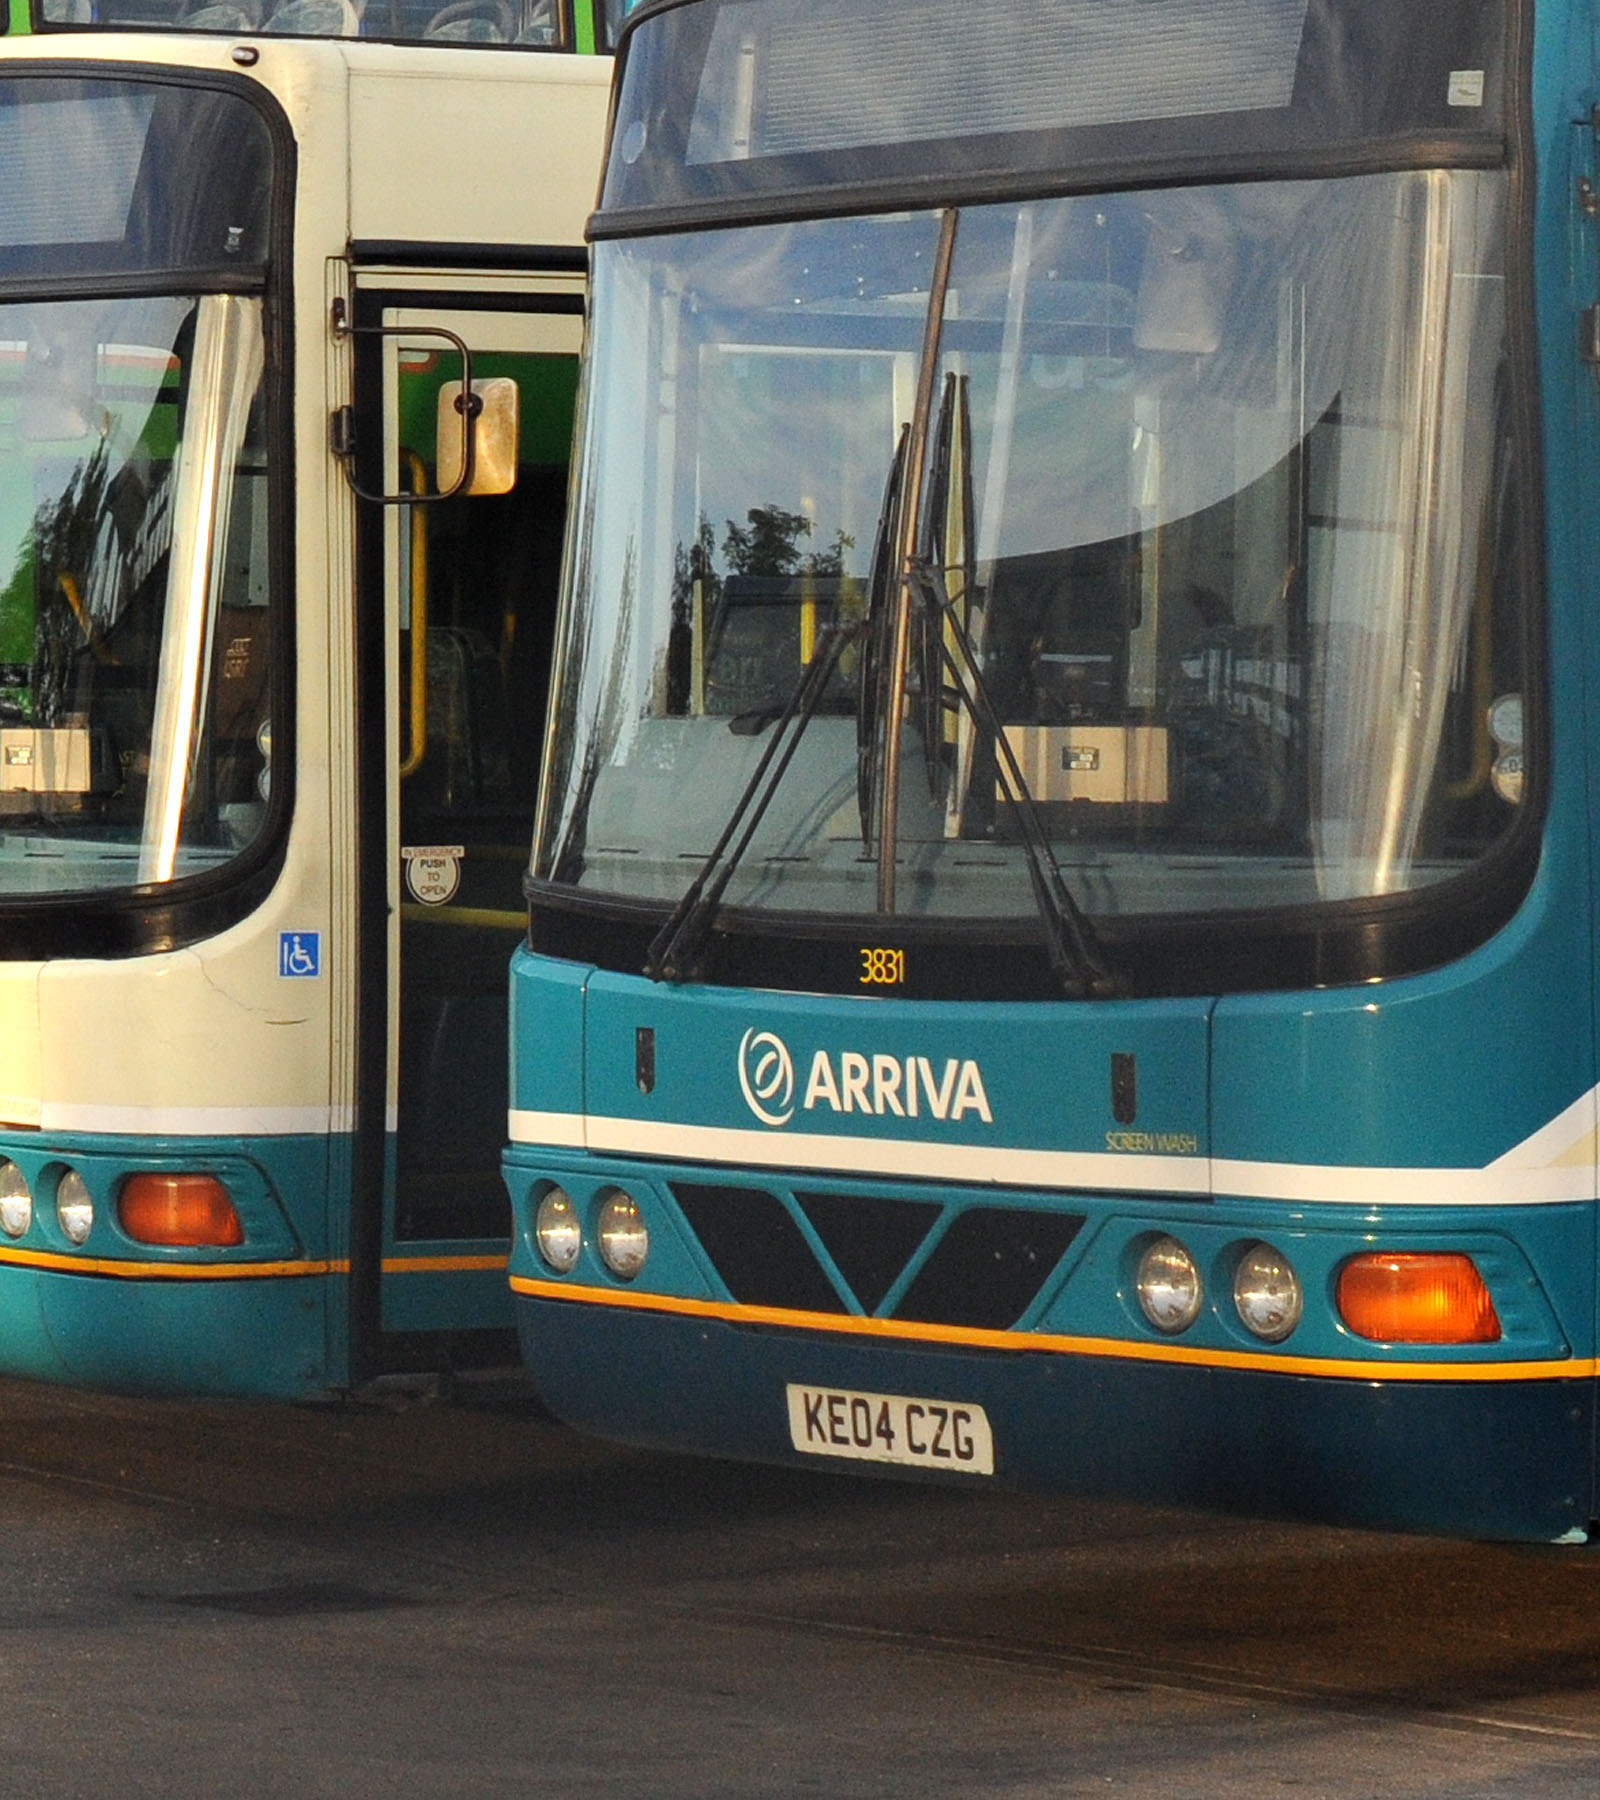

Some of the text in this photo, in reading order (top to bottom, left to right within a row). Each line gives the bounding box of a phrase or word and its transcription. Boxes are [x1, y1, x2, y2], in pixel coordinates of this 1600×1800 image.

[420, 858, 447, 869] PUSH
[427, 871, 440, 882] TO
[420, 885, 447, 896] OPEN
[859, 948, 905, 984] 3831
[803, 1050, 993, 1123] ARRIVA
[1105, 1131, 1197, 1153] SCREEN WASH
[803, 1392, 974, 1461] KE04 CZG
